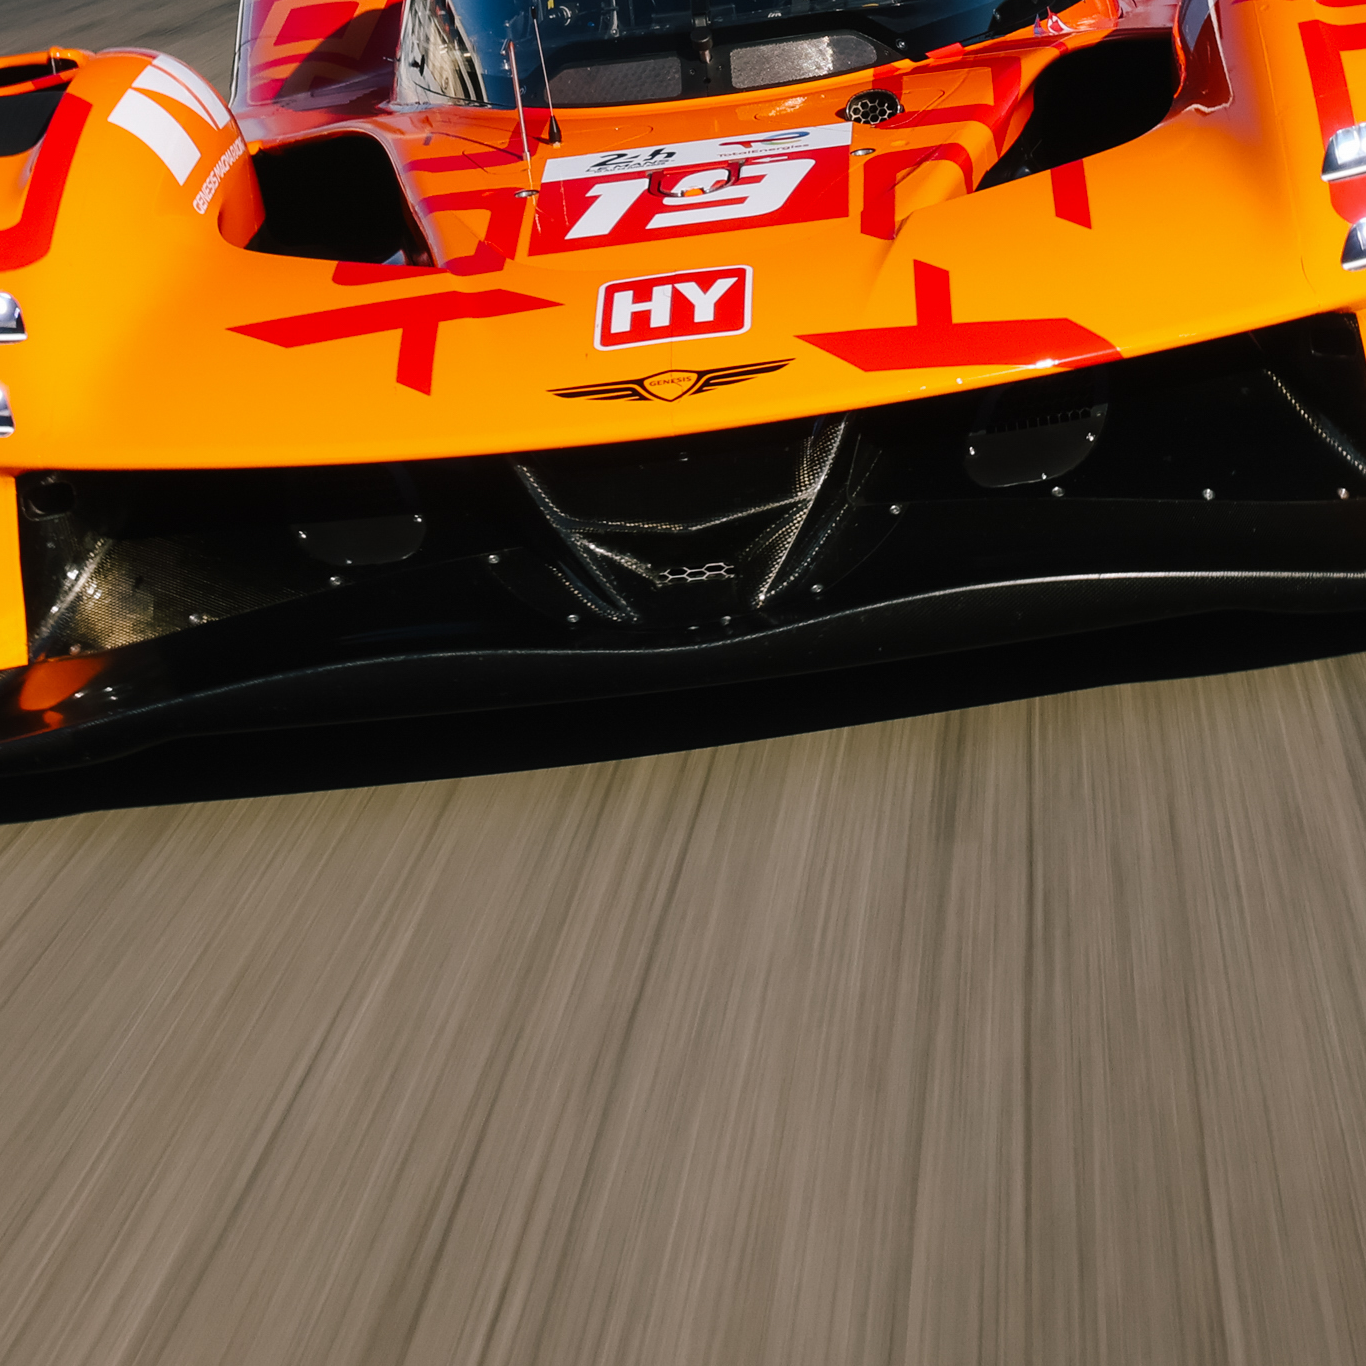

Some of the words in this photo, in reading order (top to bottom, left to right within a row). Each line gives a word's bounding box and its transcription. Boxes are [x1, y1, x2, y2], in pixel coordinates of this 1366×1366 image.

[717, 143, 810, 158] TotalEnergies
[192, 169, 221, 215] GENESIS
[563, 157, 817, 241] 19
[609, 277, 739, 334] HY
[649, 376, 692, 387] GENESIS
